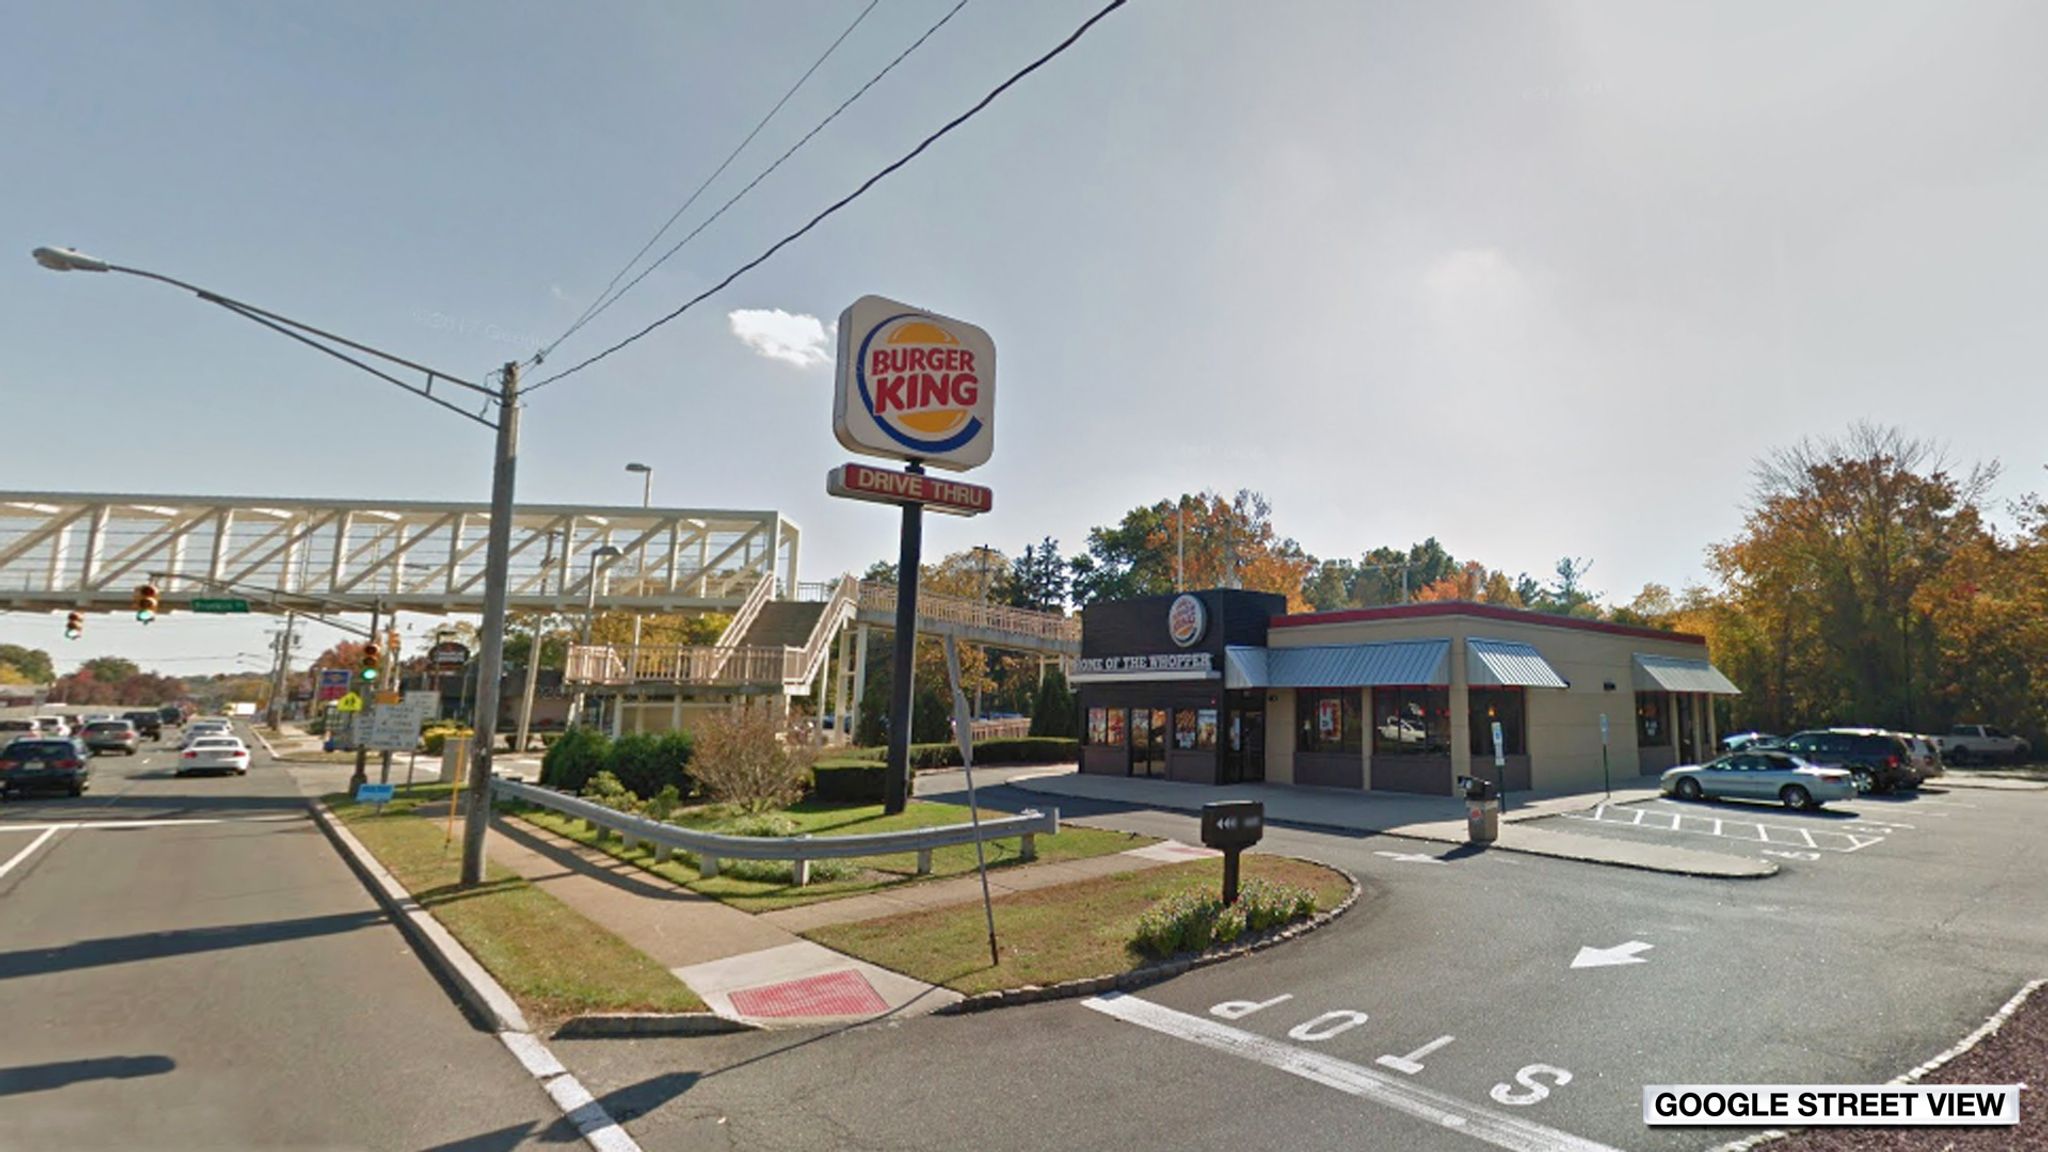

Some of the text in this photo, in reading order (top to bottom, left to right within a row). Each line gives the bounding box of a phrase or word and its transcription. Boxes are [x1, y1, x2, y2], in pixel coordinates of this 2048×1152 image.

[871, 347, 976, 376] BURGER
[874, 373, 979, 415] KING
[858, 470, 983, 506] DRIVE THRU
[1105, 657, 1121, 670] OF
[1122, 656, 1147, 669] THE
[1148, 653, 1213, 669] WHOPPER
